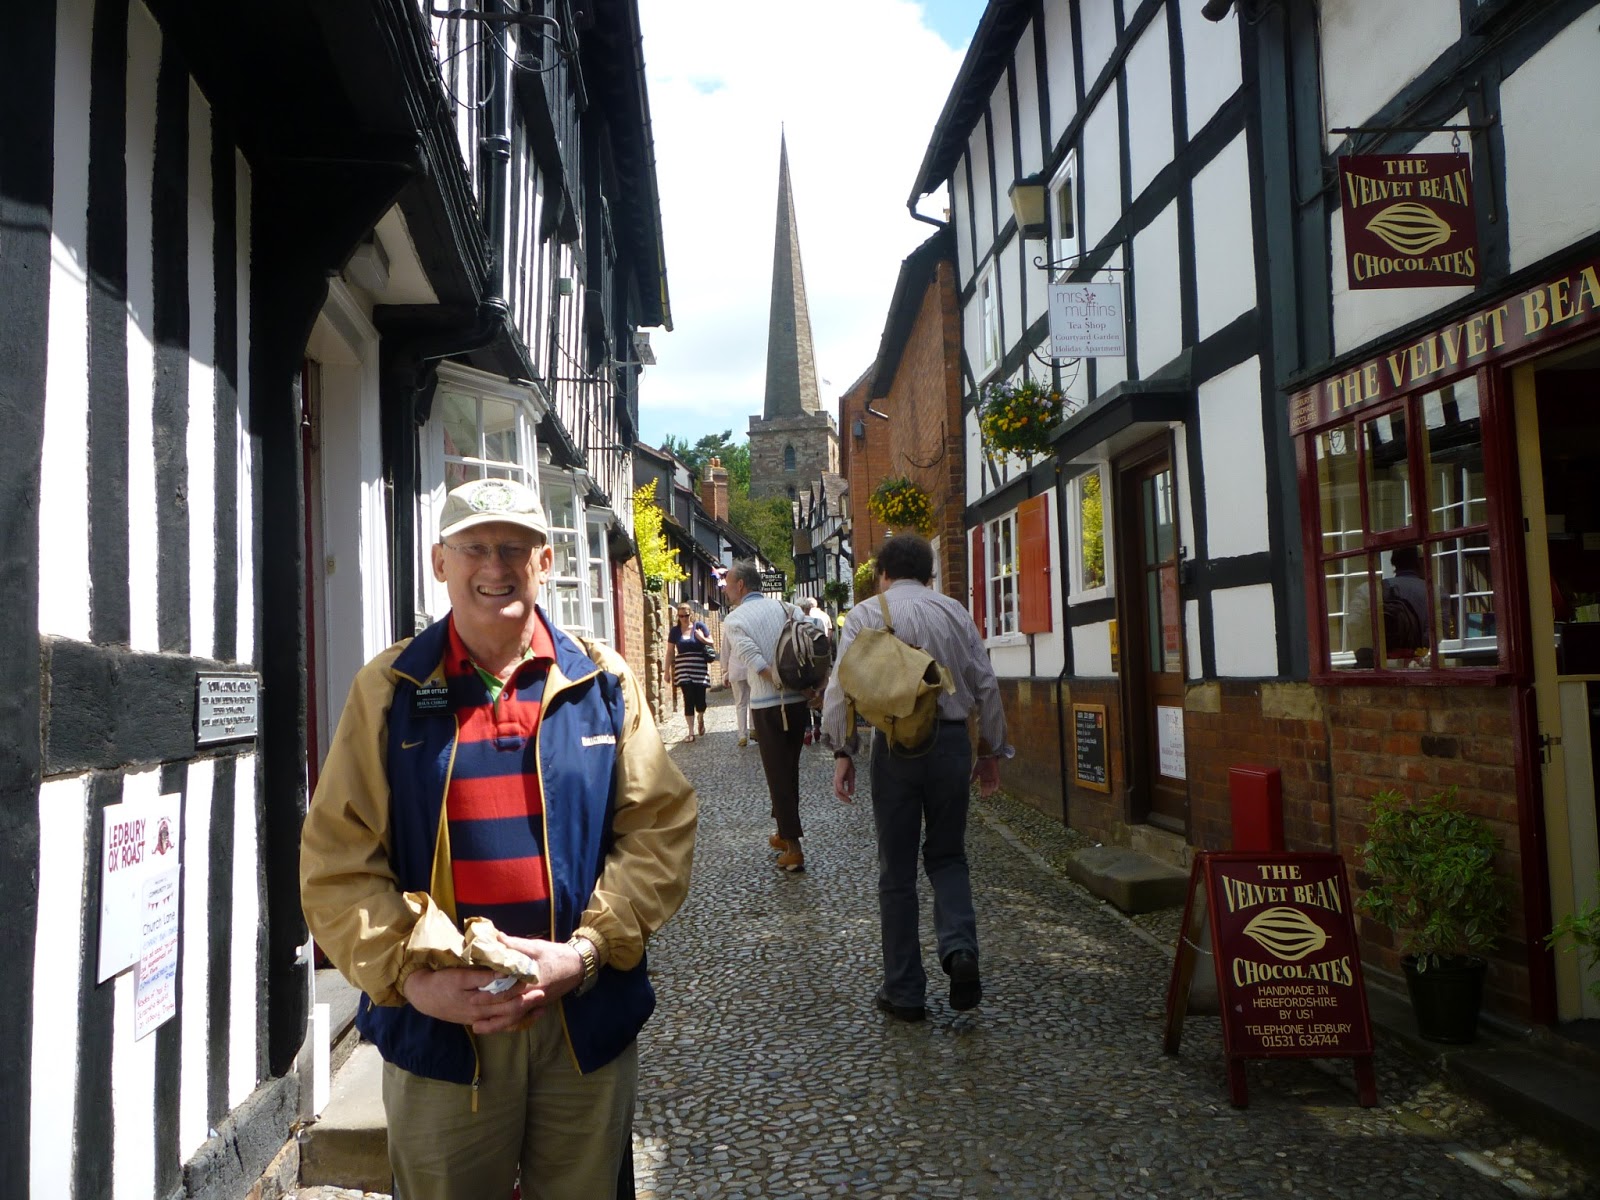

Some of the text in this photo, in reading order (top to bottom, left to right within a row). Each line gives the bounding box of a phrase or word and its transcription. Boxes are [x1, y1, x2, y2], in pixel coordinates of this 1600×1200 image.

[1383, 159, 1428, 175] THE
[1346, 168, 1469, 209] VELVET BEAN
[1353, 247, 1476, 282] CHOCOLATES
[1056, 291, 1082, 304] mrs
[1065, 302, 1116, 317] muffins
[1066, 321, 1107, 331] Tea Shop
[1055, 334, 1091, 342] Courtyard
[1055, 345, 1121, 354] Holiday Apartment
[1327, 362, 1380, 413] THE
[1386, 304, 1509, 388] VELVET
[1292, 412, 1317, 427] CHOCOLATES
[109, 818, 146, 849] LEDBURY
[108, 840, 145, 873] OX ROAST
[1257, 865, 1302, 880] THE
[1222, 875, 1342, 914] VELVET BEAN
[142, 910, 176, 936] Church Lane
[1232, 956, 1354, 988] CHOCOLATES
[1258, 985, 1329, 996] HANDMADE IN
[1252, 997, 1338, 1008] HEREFORDSHIRE
[1279, 1009, 1314, 1020] BY US!
[1245, 1023, 1352, 1036] TELEPHONE LEDBURY
[1262, 1034, 1340, 1048] 01531 634744
